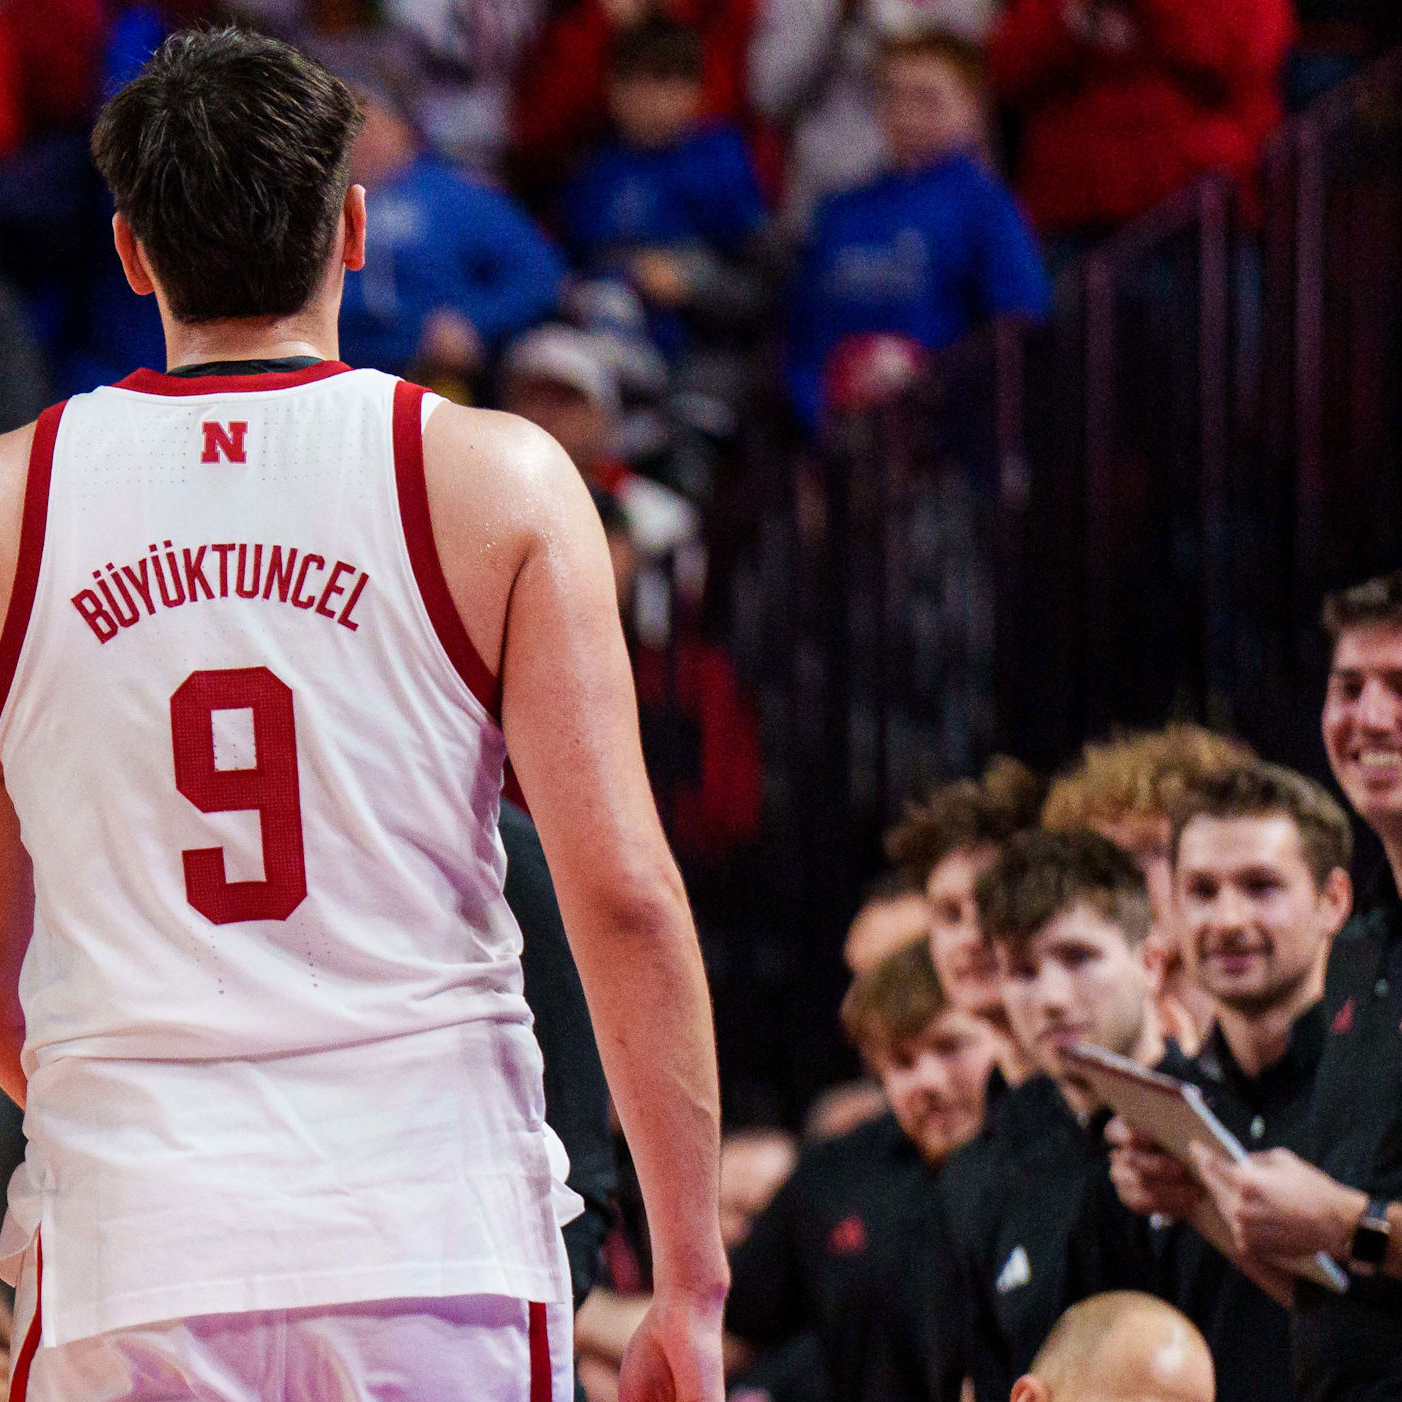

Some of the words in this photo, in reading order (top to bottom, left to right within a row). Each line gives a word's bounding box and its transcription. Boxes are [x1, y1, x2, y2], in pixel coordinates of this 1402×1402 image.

[200, 421, 248, 464] N
[70, 540, 371, 645] BÜYÜKTUNCEL
[170, 666, 308, 925] 9
